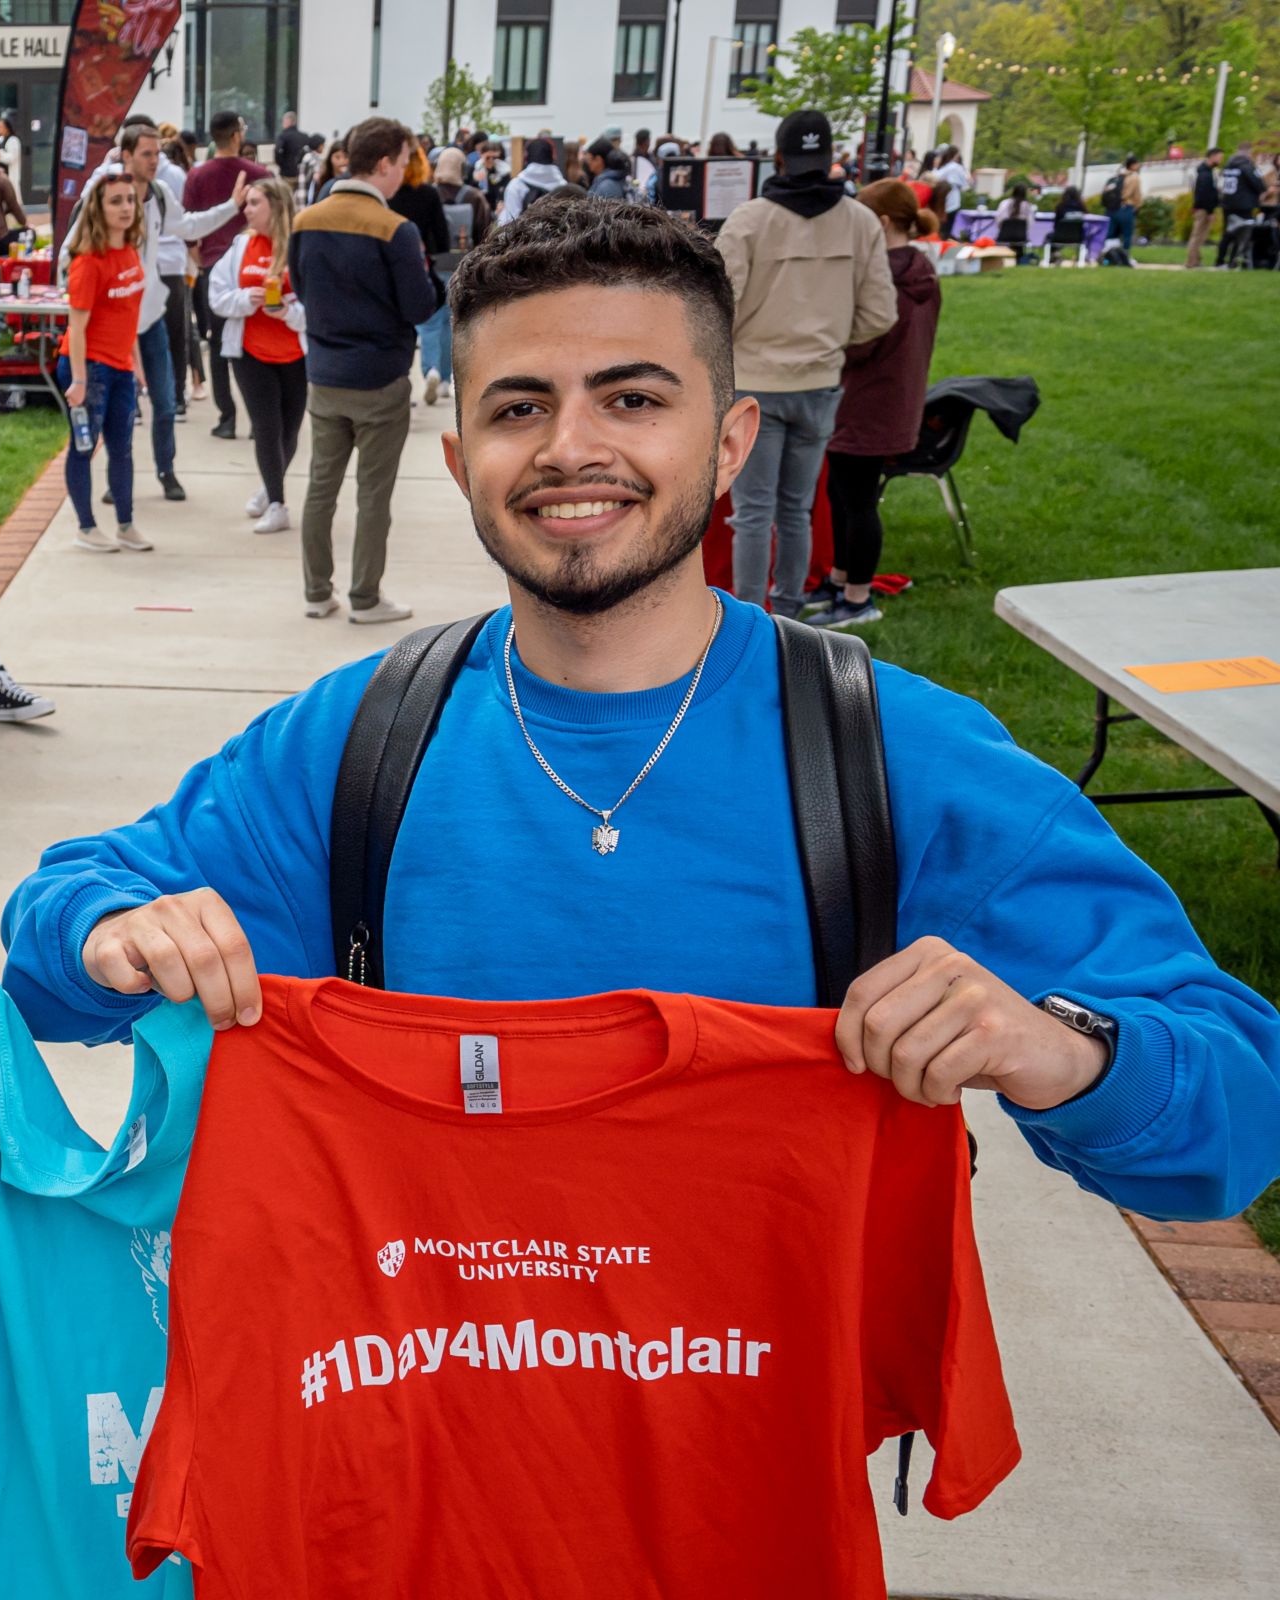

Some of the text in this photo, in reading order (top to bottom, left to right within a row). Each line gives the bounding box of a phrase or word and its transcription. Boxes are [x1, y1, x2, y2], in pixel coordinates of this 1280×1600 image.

[24, 37, 62, 58] HALL
[414, 1237, 651, 1265] MONTCLAIR STATE
[458, 1260, 599, 1283] UNIVERSITY
[301, 1319, 771, 1409] #1Day4Montclair
[86, 1386, 166, 1486] M
